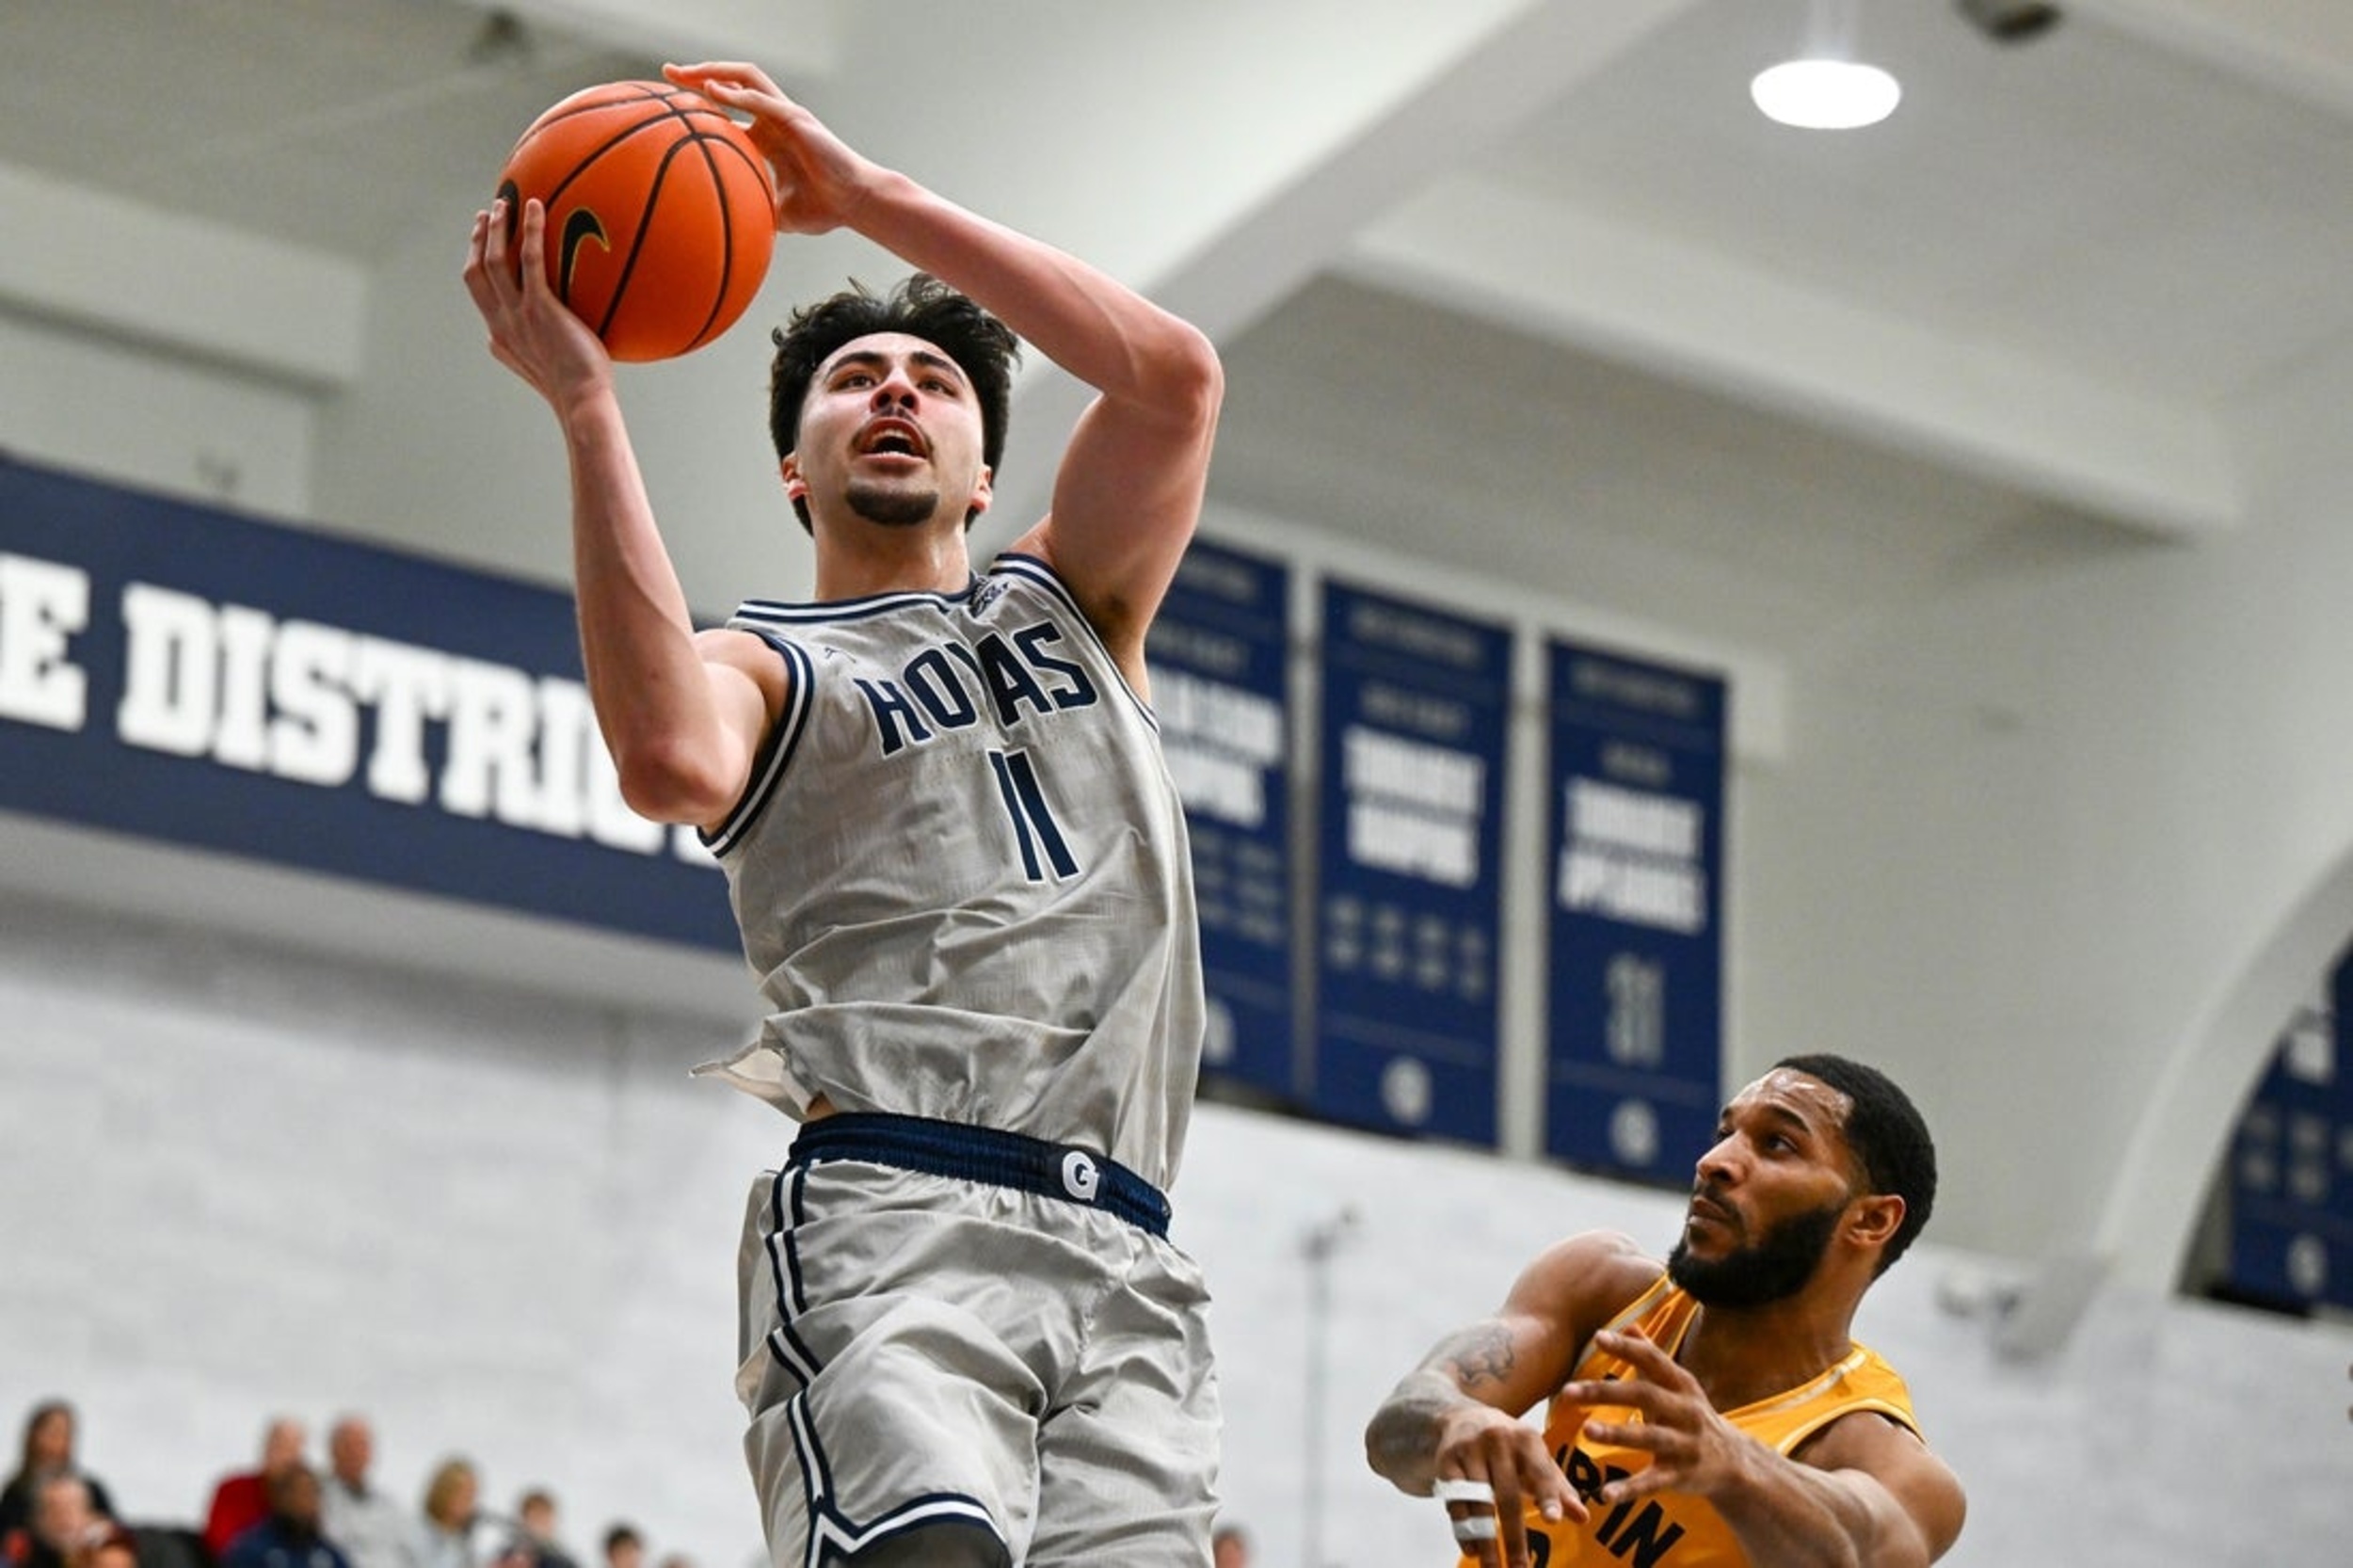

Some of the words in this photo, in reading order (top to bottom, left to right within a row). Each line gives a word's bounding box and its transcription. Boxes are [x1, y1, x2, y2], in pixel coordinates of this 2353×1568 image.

[118, 581, 725, 870] DISTRI
[987, 749, 1080, 882] 11
[1063, 1150, 1100, 1202] G
